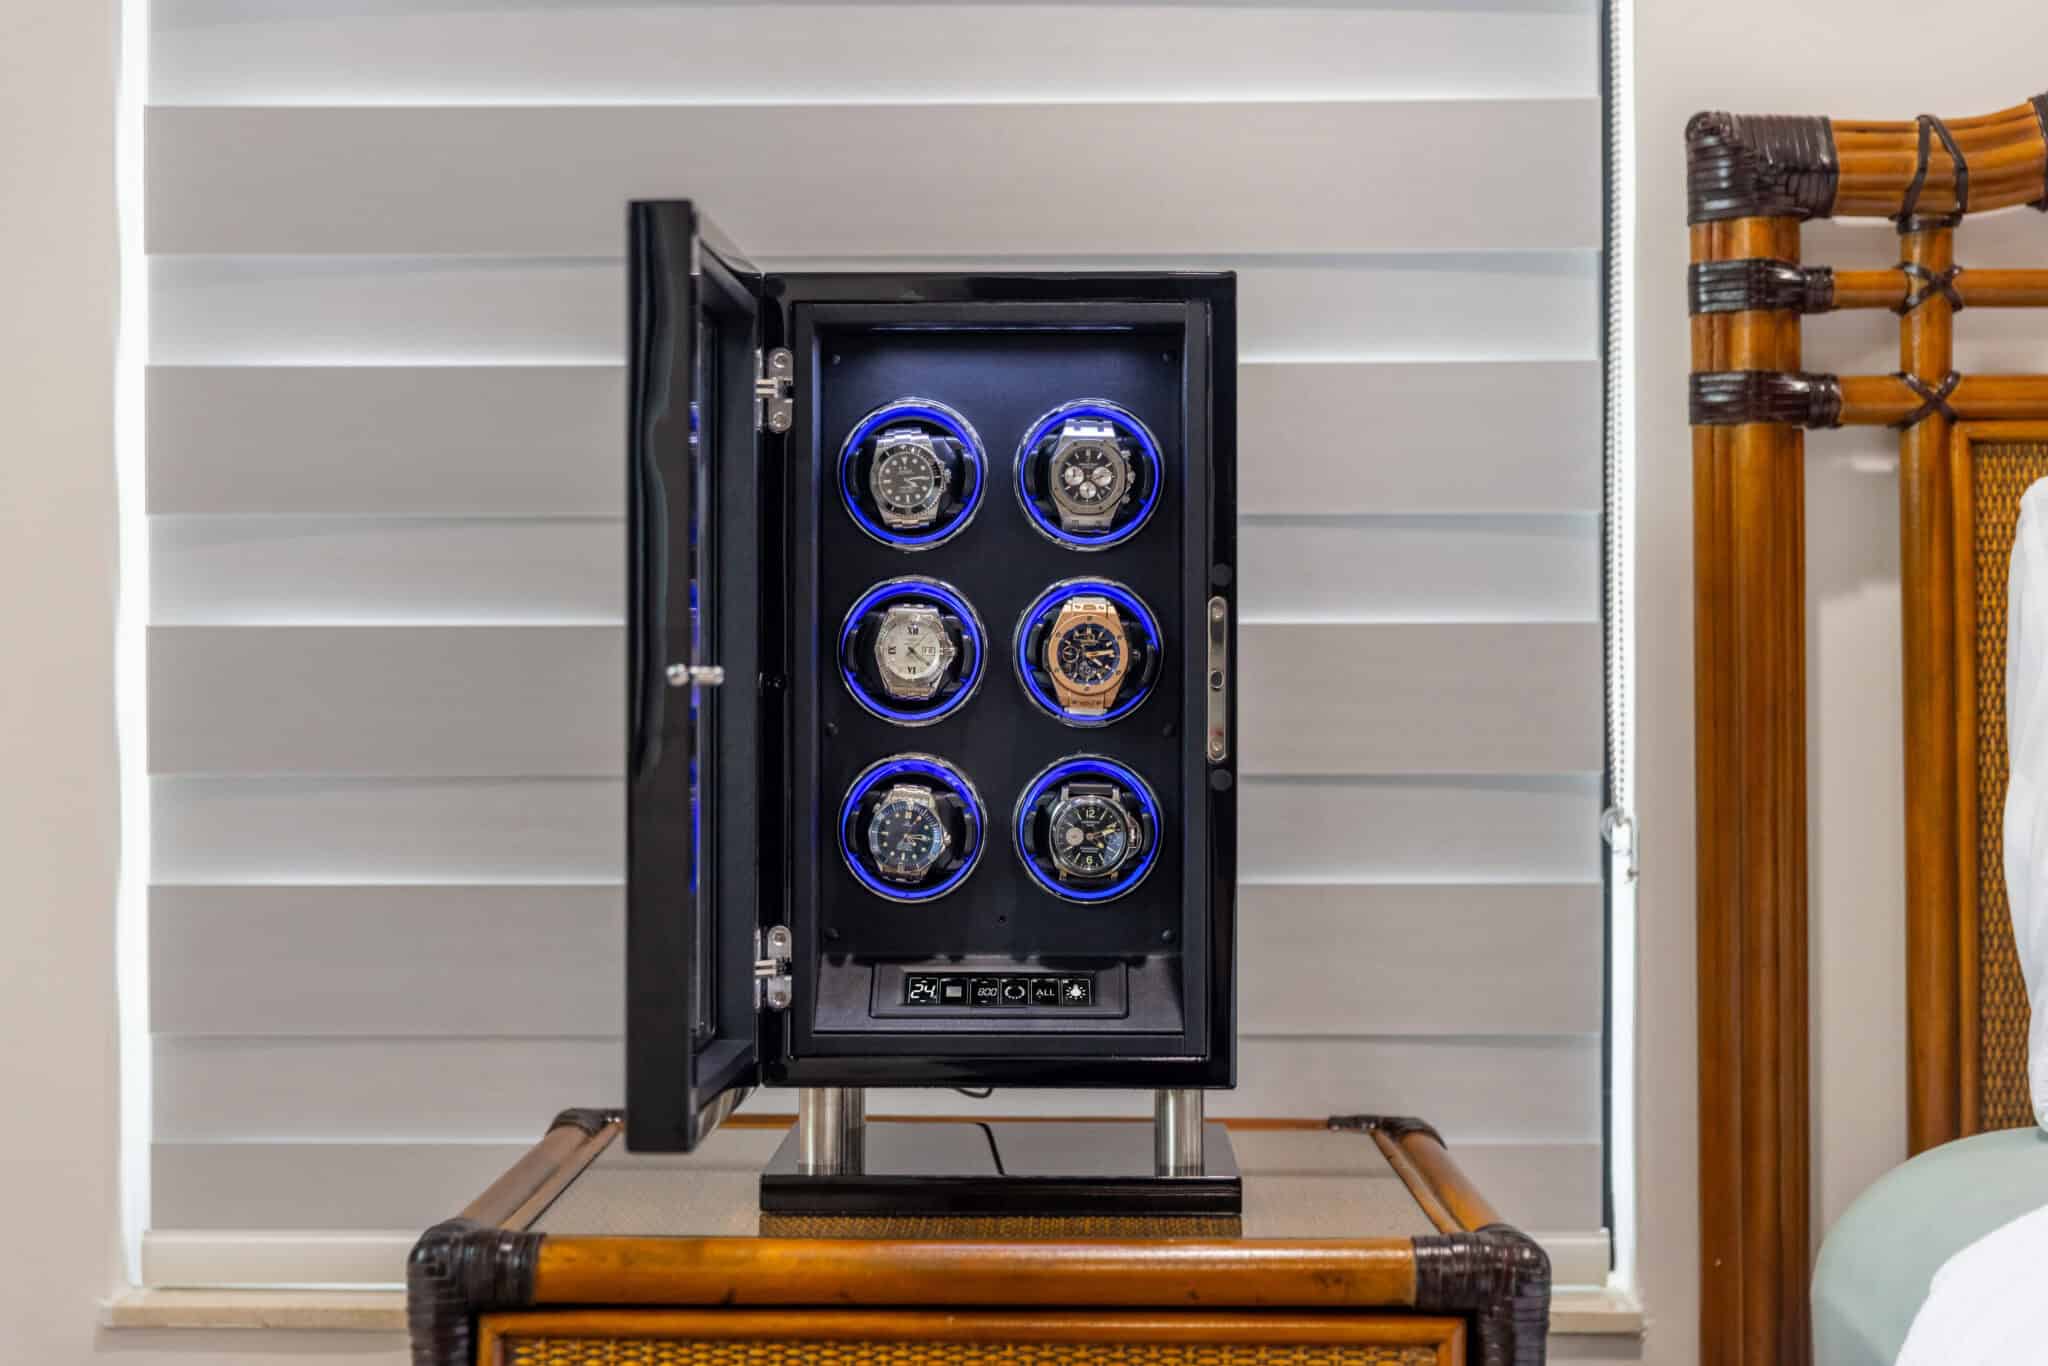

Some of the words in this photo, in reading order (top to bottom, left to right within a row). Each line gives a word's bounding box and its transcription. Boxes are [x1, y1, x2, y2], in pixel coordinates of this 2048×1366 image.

[1086, 809, 1096, 818] 12
[1086, 855, 1093, 865] 6
[977, 987, 998, 997] 800
[1036, 987, 1056, 998] ALL
